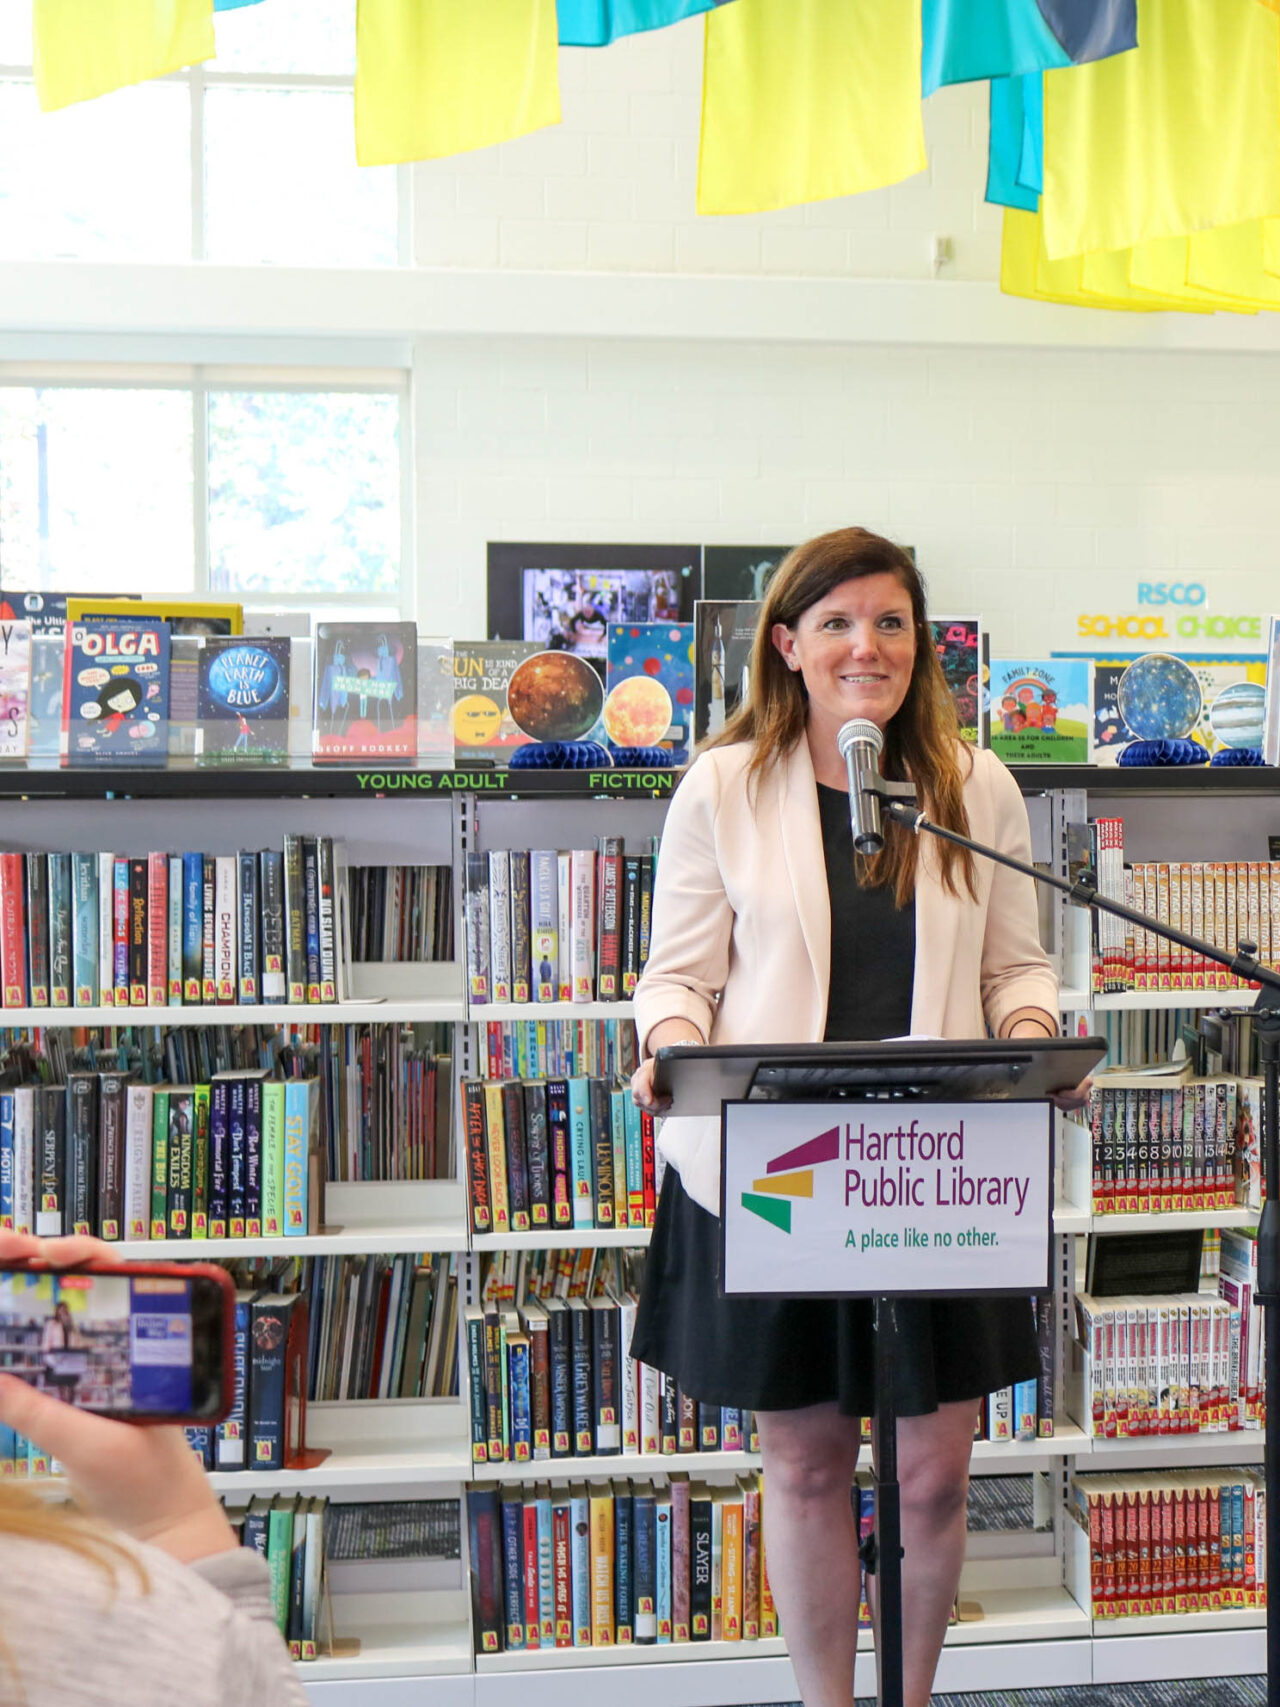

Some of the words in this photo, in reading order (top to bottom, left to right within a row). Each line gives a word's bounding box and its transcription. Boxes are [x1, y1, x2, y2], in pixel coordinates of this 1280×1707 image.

[1138, 582, 1207, 605] RSCO
[1077, 615, 1170, 639] SCHOOL
[1177, 616, 1262, 639] CHOICE
[81, 631, 161, 657] OLGA
[221, 652, 269, 669] PLANET
[440, 656, 484, 677] SUN
[225, 666, 265, 683] EARTH
[239, 680, 250, 690] IS
[454, 677, 476, 690] BIG
[482, 676, 509, 691] DEA
[1002, 666, 1031, 683] FAMILY
[1033, 667, 1055, 684] ZONE
[227, 688, 262, 705] BLUE
[362, 744, 409, 753] RODKEY
[356, 773, 433, 789] YOUNG
[438, 773, 509, 789] ADULT
[589, 773, 673, 788] FICTION
[605, 861, 616, 887] JAMES
[321, 899, 333, 914] NO
[605, 887, 616, 930] PATTERSON
[641, 895, 650, 937] MIDNIGHT
[133, 897, 145, 945] Reflection
[243, 898, 252, 943] KINGDOM
[292, 909, 301, 951] BATMAN
[321, 915, 333, 950] SLAM
[221, 912, 231, 981] CHAMPION
[601, 934, 618, 967] HAWK
[322, 950, 334, 982] DUNK
[249, 1135, 259, 1153] Red
[287, 1115, 303, 1157] STAY
[576, 1121, 585, 1156] CRYING
[845, 1119, 964, 1161] Hartford
[45, 1130, 55, 1176] SERPENT
[181, 1134, 191, 1189] KINGDOM
[1116, 1147, 1125, 1160] 3
[1139, 1146, 1148, 1159] 6
[1150, 1146, 1160, 1160] 8
[1161, 1145, 1171, 1159] 9
[1183, 1145, 1193, 1158] 12
[1, 1147, 11, 1184] MOTH
[171, 1147, 180, 1188] EXILES
[249, 1154, 259, 1187] Winter
[285, 1161, 302, 1212] GOLD
[845, 1166, 925, 1207] Public
[936, 1164, 1030, 1217] Library
[845, 1229, 857, 1248] A
[861, 1228, 899, 1252] place
[904, 1227, 929, 1248] like
[934, 1231, 952, 1247] no
[957, 1227, 999, 1247] other.
[996, 1402, 1007, 1419] UP
[620, 1522, 628, 1542] THE
[696, 1532, 710, 1585] SLAYER
[620, 1585, 628, 1621] FOREST
[763, 1595, 774, 1613] SPY
